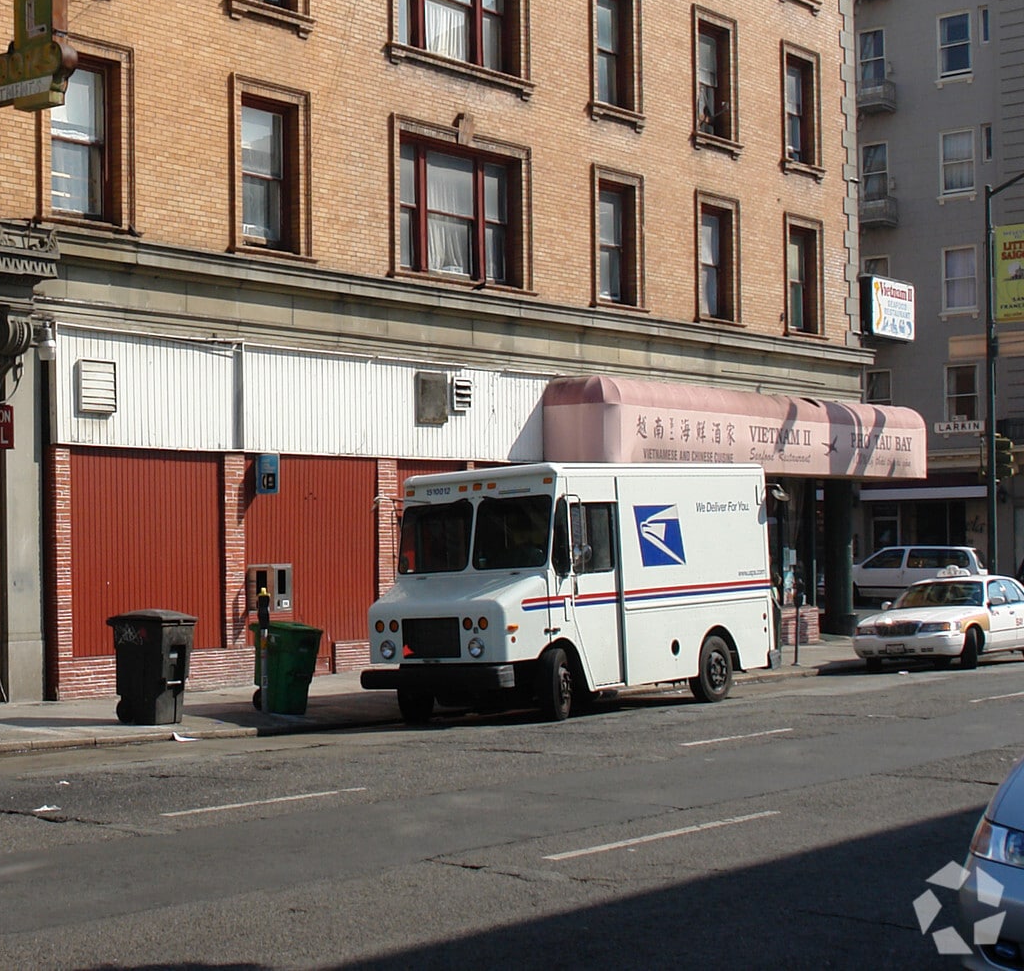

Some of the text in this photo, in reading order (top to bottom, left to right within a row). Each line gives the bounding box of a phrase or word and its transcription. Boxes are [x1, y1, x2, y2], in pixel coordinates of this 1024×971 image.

[880, 281, 907, 301] Vietnam
[938, 422, 980, 432] LARKIN
[749, 425, 812, 447] VIETNAM II
[895, 435, 913, 452] BAY
[643, 448, 678, 461] VIETNAMESE
[679, 450, 691, 461] AND
[691, 451, 714, 463] CHINESE
[696, 502, 706, 512] We
[706, 501, 727, 513] Deliver
[727, 501, 737, 512] For
